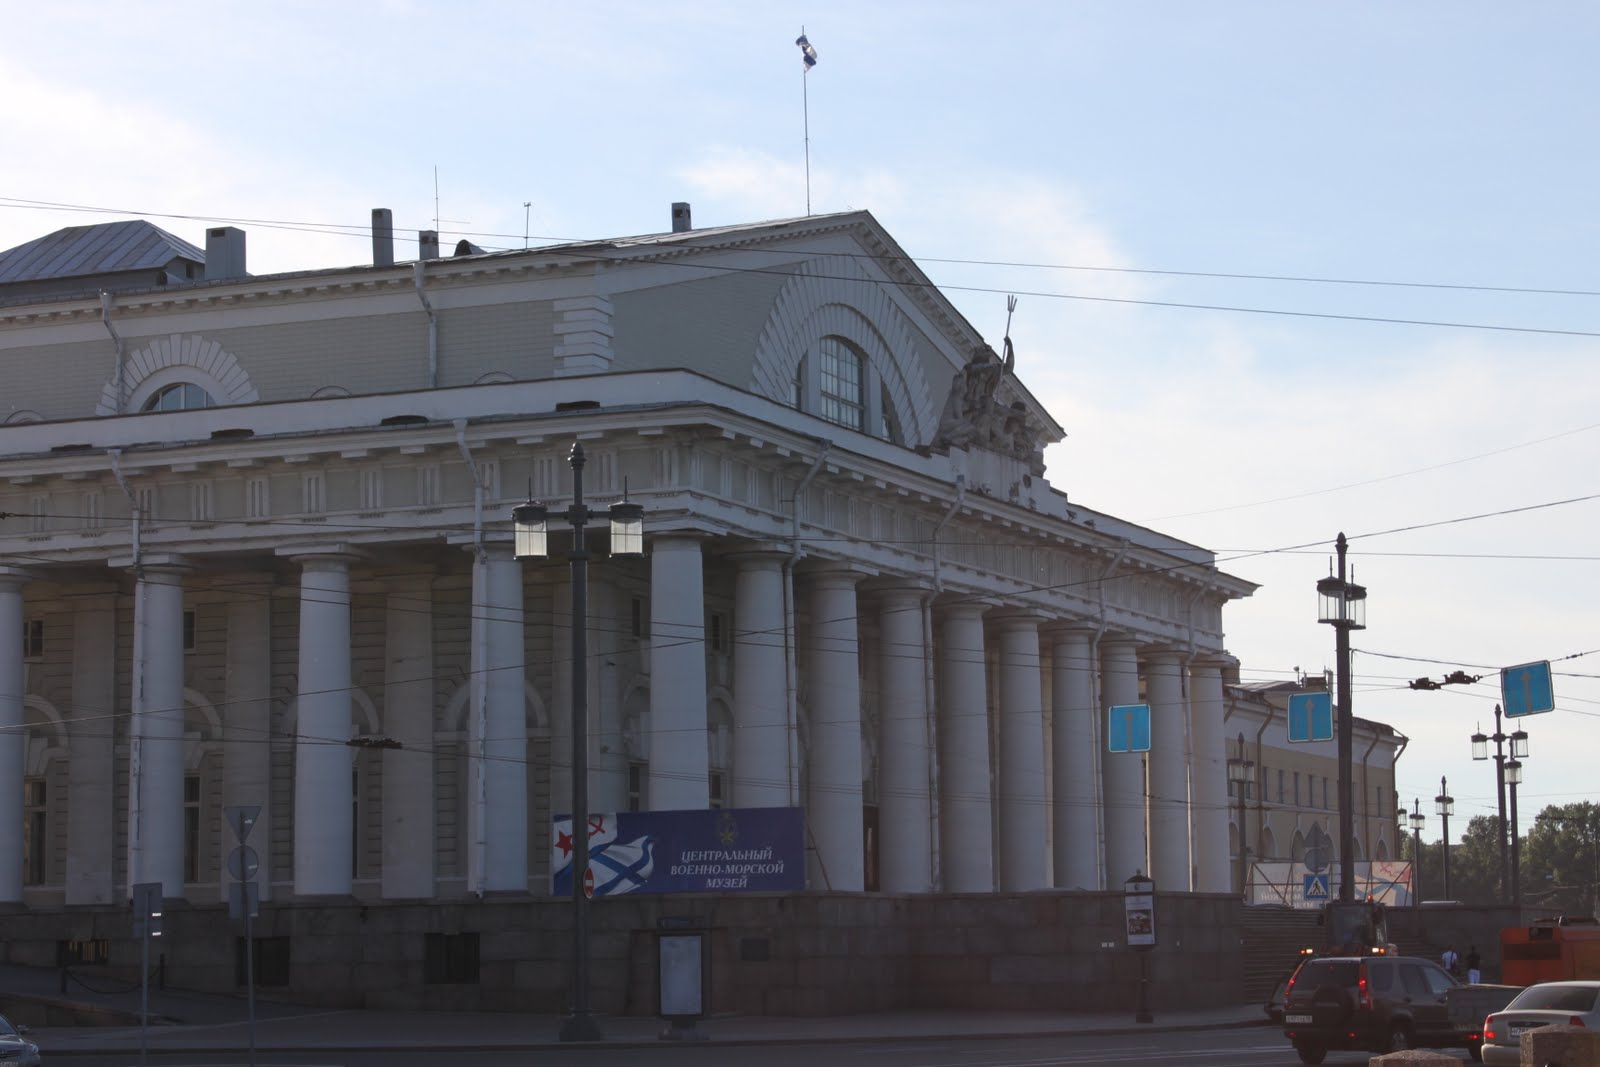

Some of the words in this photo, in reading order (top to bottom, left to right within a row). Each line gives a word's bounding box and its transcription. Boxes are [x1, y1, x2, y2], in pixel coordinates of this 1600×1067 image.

[682, 847, 772, 863] ЦЕНТРАЛЬНЫЙ
[670, 861, 784, 875] ВОЕННО-МОРСКОЙ
[706, 875, 748, 888] МУЗЕЙ
